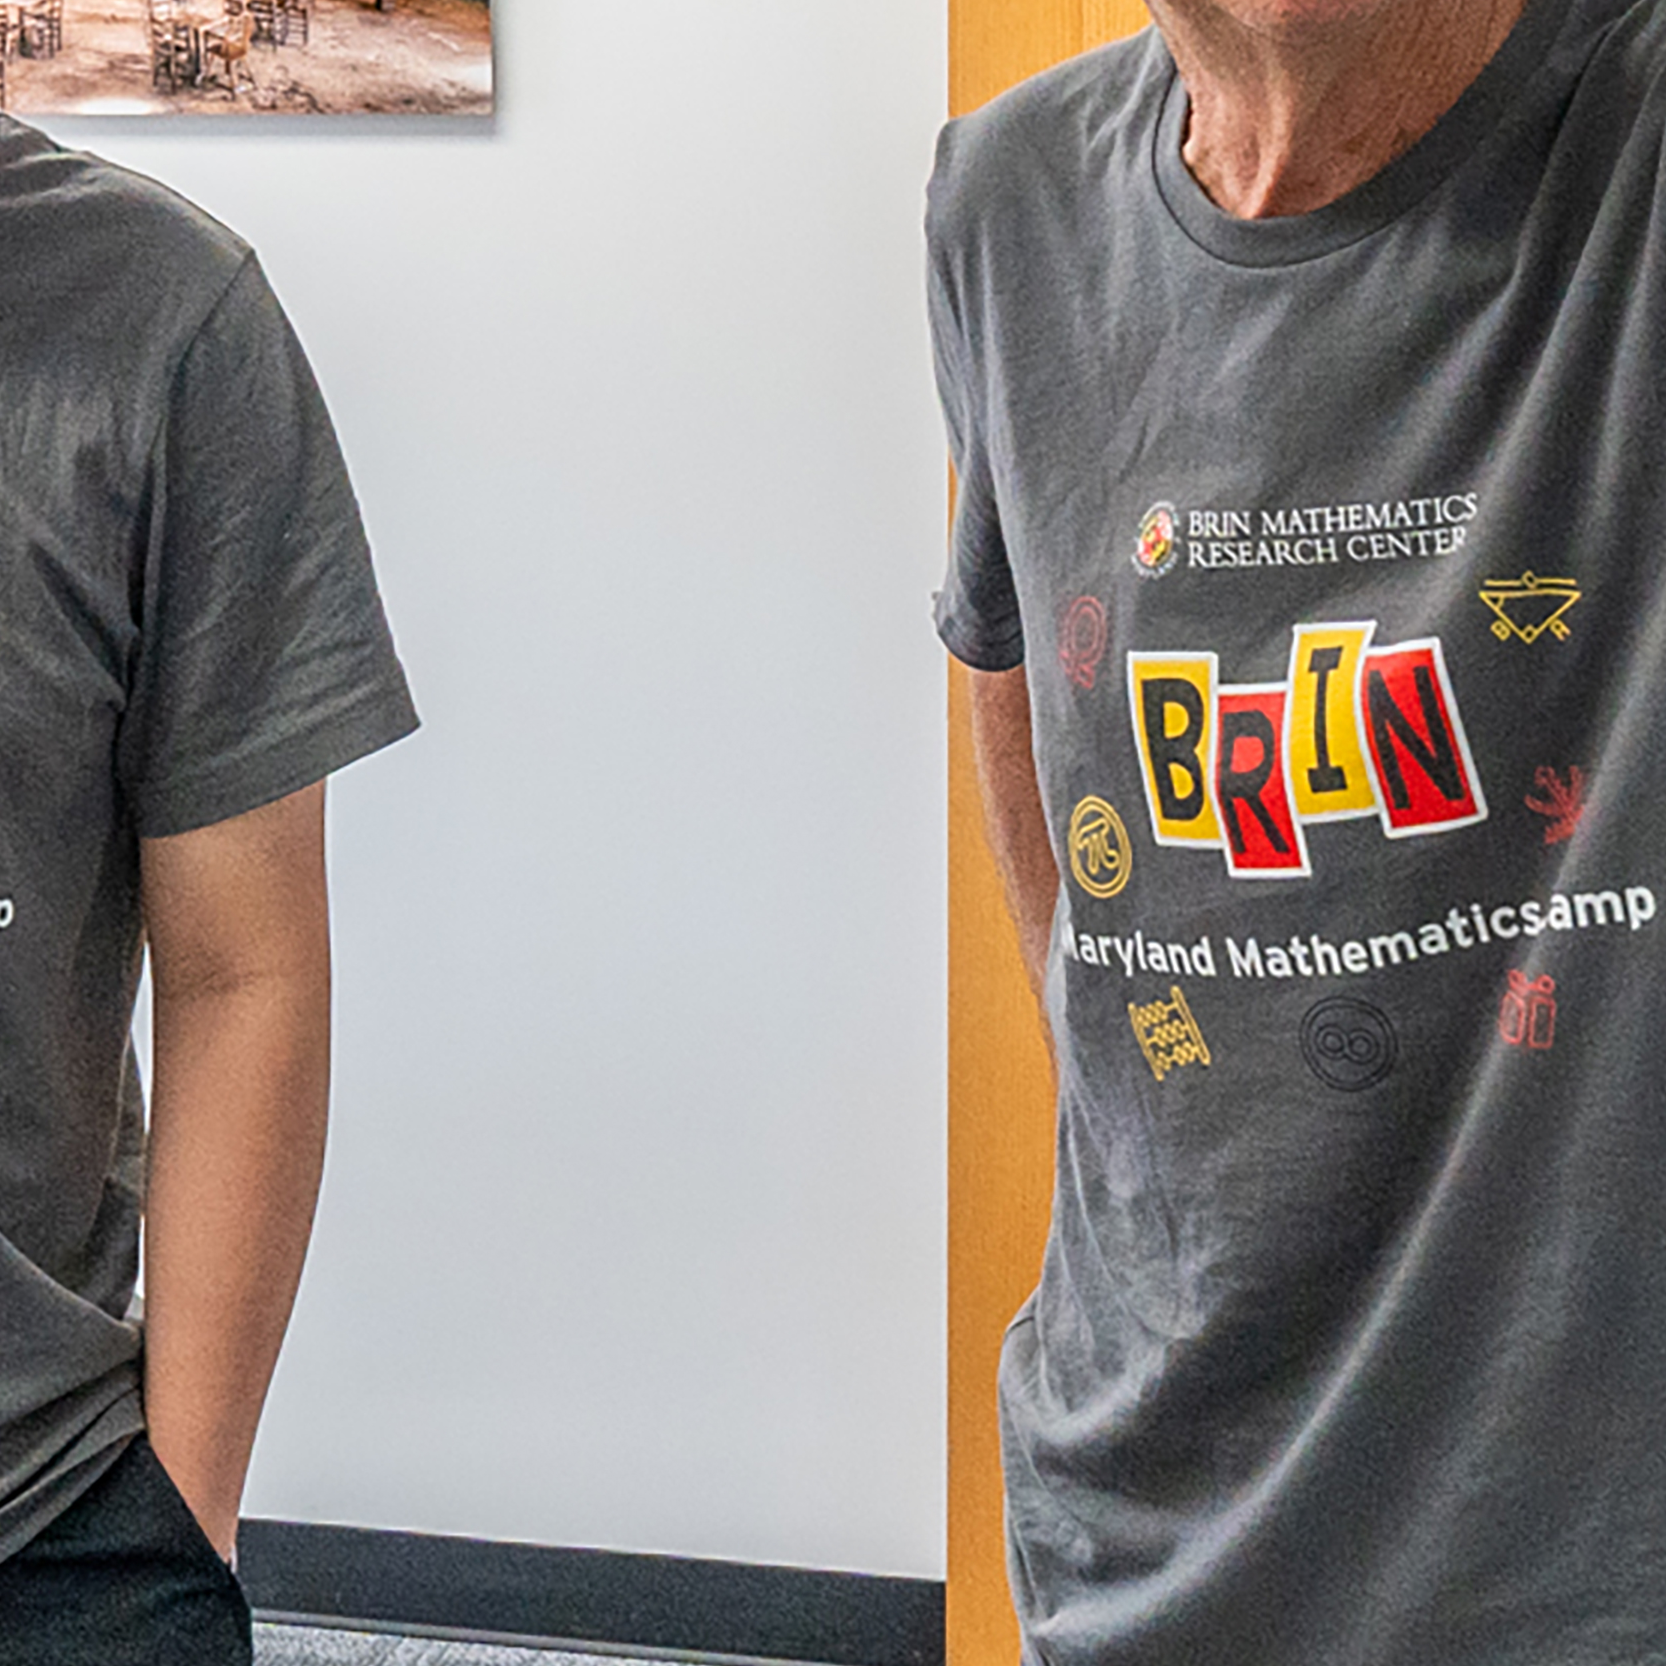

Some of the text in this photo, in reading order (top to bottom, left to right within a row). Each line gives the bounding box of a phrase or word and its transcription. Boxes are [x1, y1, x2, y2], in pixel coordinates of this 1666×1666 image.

[1188, 510, 1252, 539] BRIN
[1260, 491, 1479, 536] MATHEMATICS
[1187, 536, 1339, 569] RESEARCH
[1346, 525, 1468, 562] CENTER
[1140, 646, 1467, 856] BRIN
